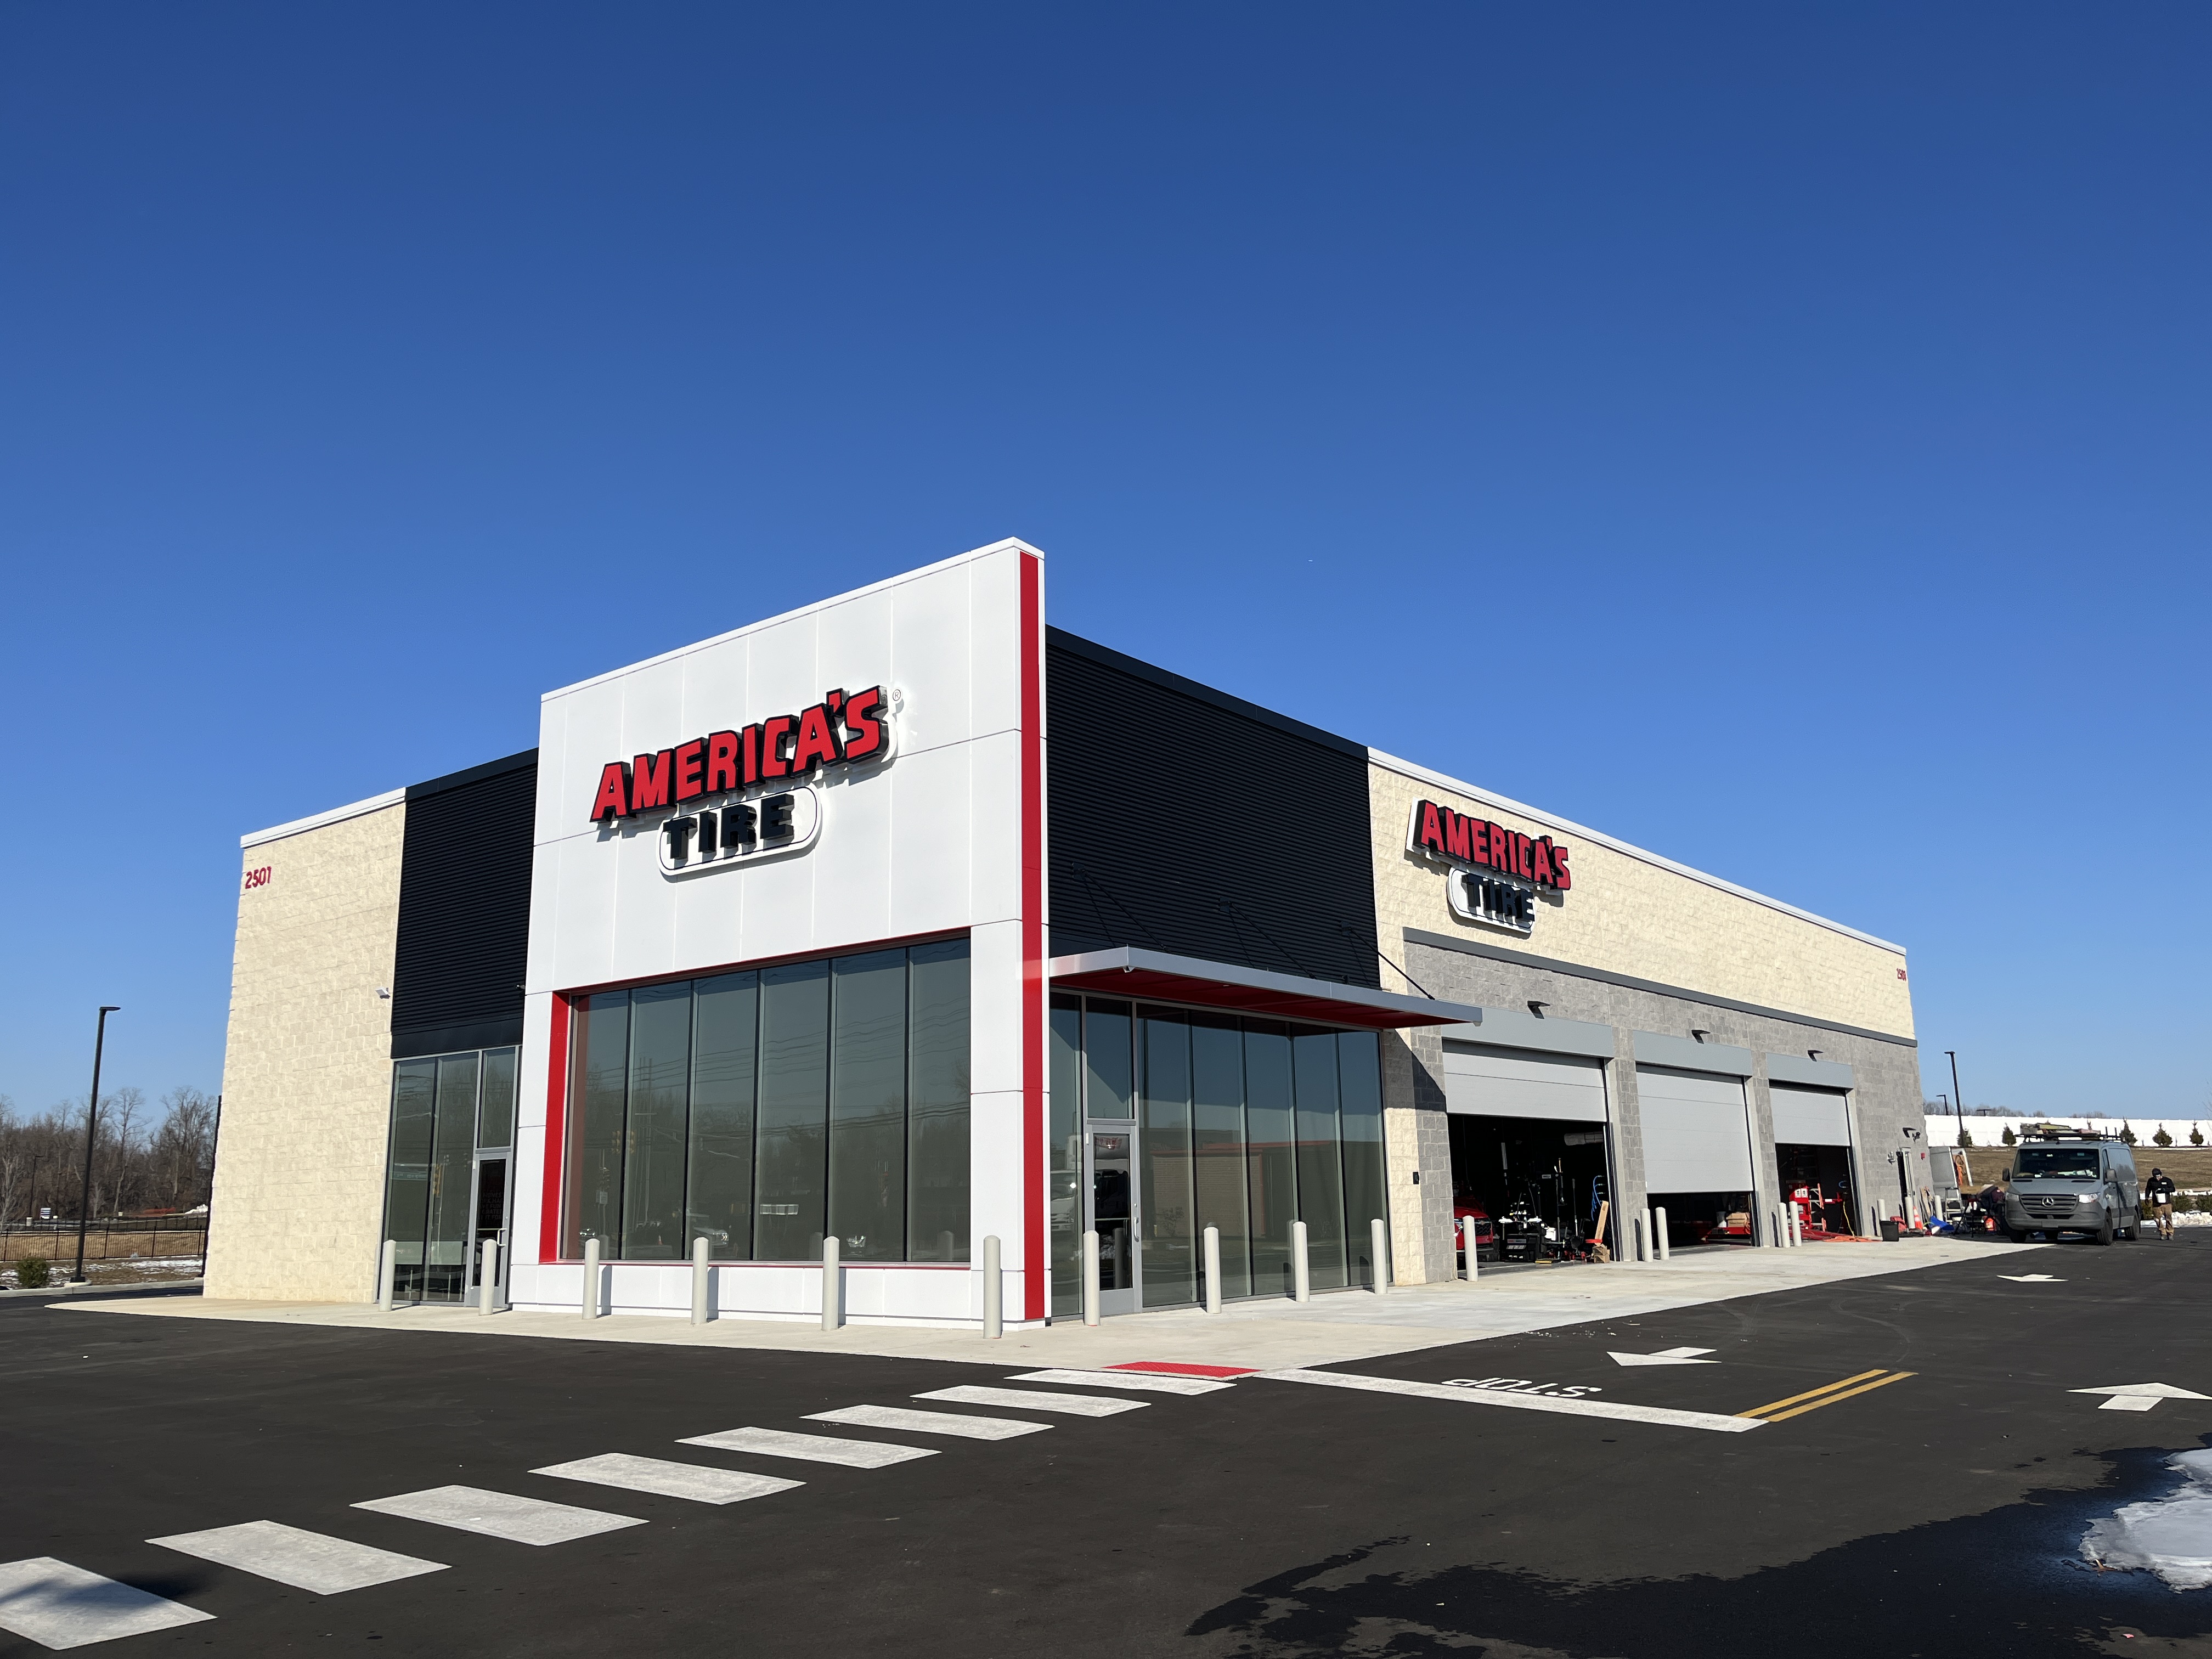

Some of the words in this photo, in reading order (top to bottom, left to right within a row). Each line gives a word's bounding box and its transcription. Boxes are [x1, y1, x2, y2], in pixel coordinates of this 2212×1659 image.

[590, 685, 889, 822] AMERICA'S
[663, 793, 794, 859] TIRE
[1413, 799, 1571, 890] AMERICA'S
[245, 866, 272, 889] 2501
[1462, 873, 1535, 922] TIRE
[1441, 1377, 1602, 1397] STOP
